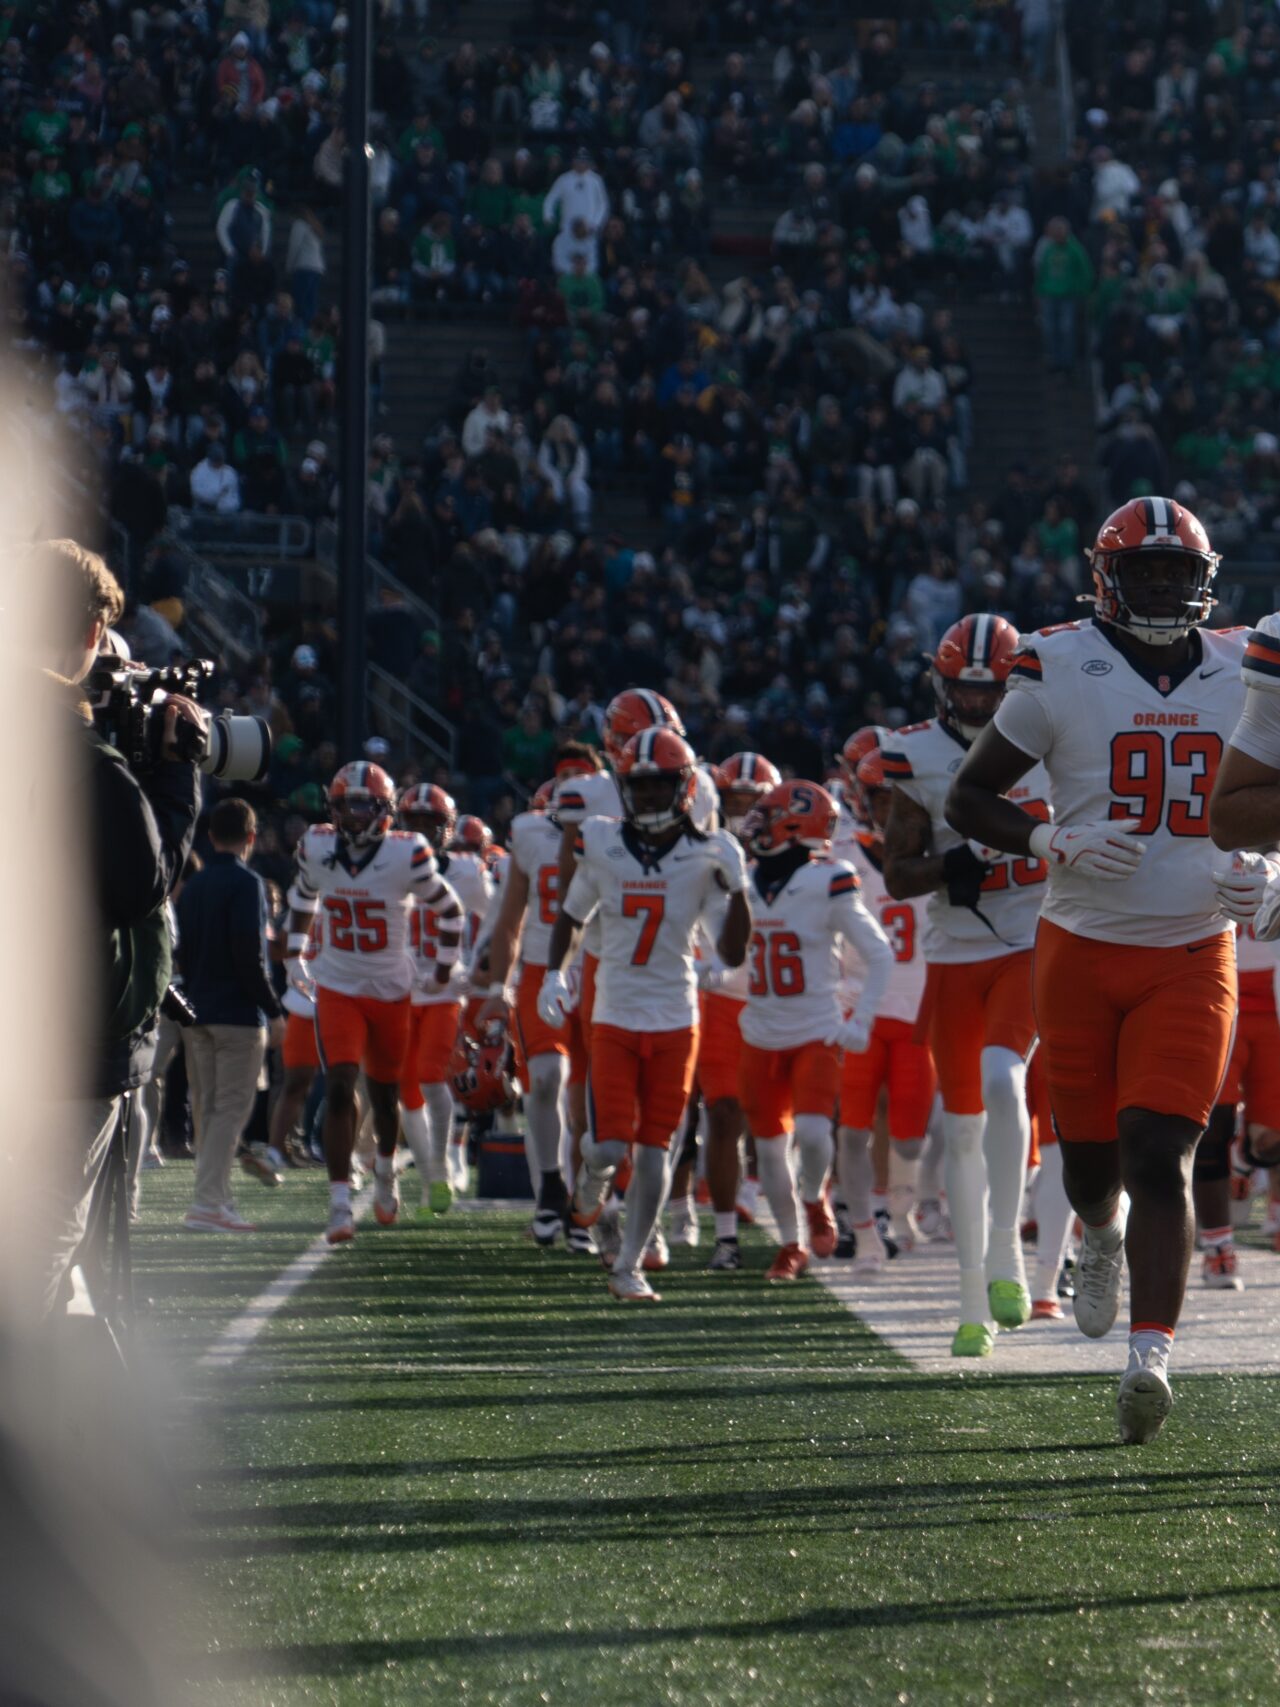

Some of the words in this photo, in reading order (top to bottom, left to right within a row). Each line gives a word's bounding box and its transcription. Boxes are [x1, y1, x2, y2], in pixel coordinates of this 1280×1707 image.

[1133, 712, 1199, 727] ORANGE
[789, 786, 814, 815] S
[1109, 730, 1224, 838] 93
[323, 896, 388, 954] 25
[622, 893, 666, 966] 7
[750, 931, 805, 996] 36
